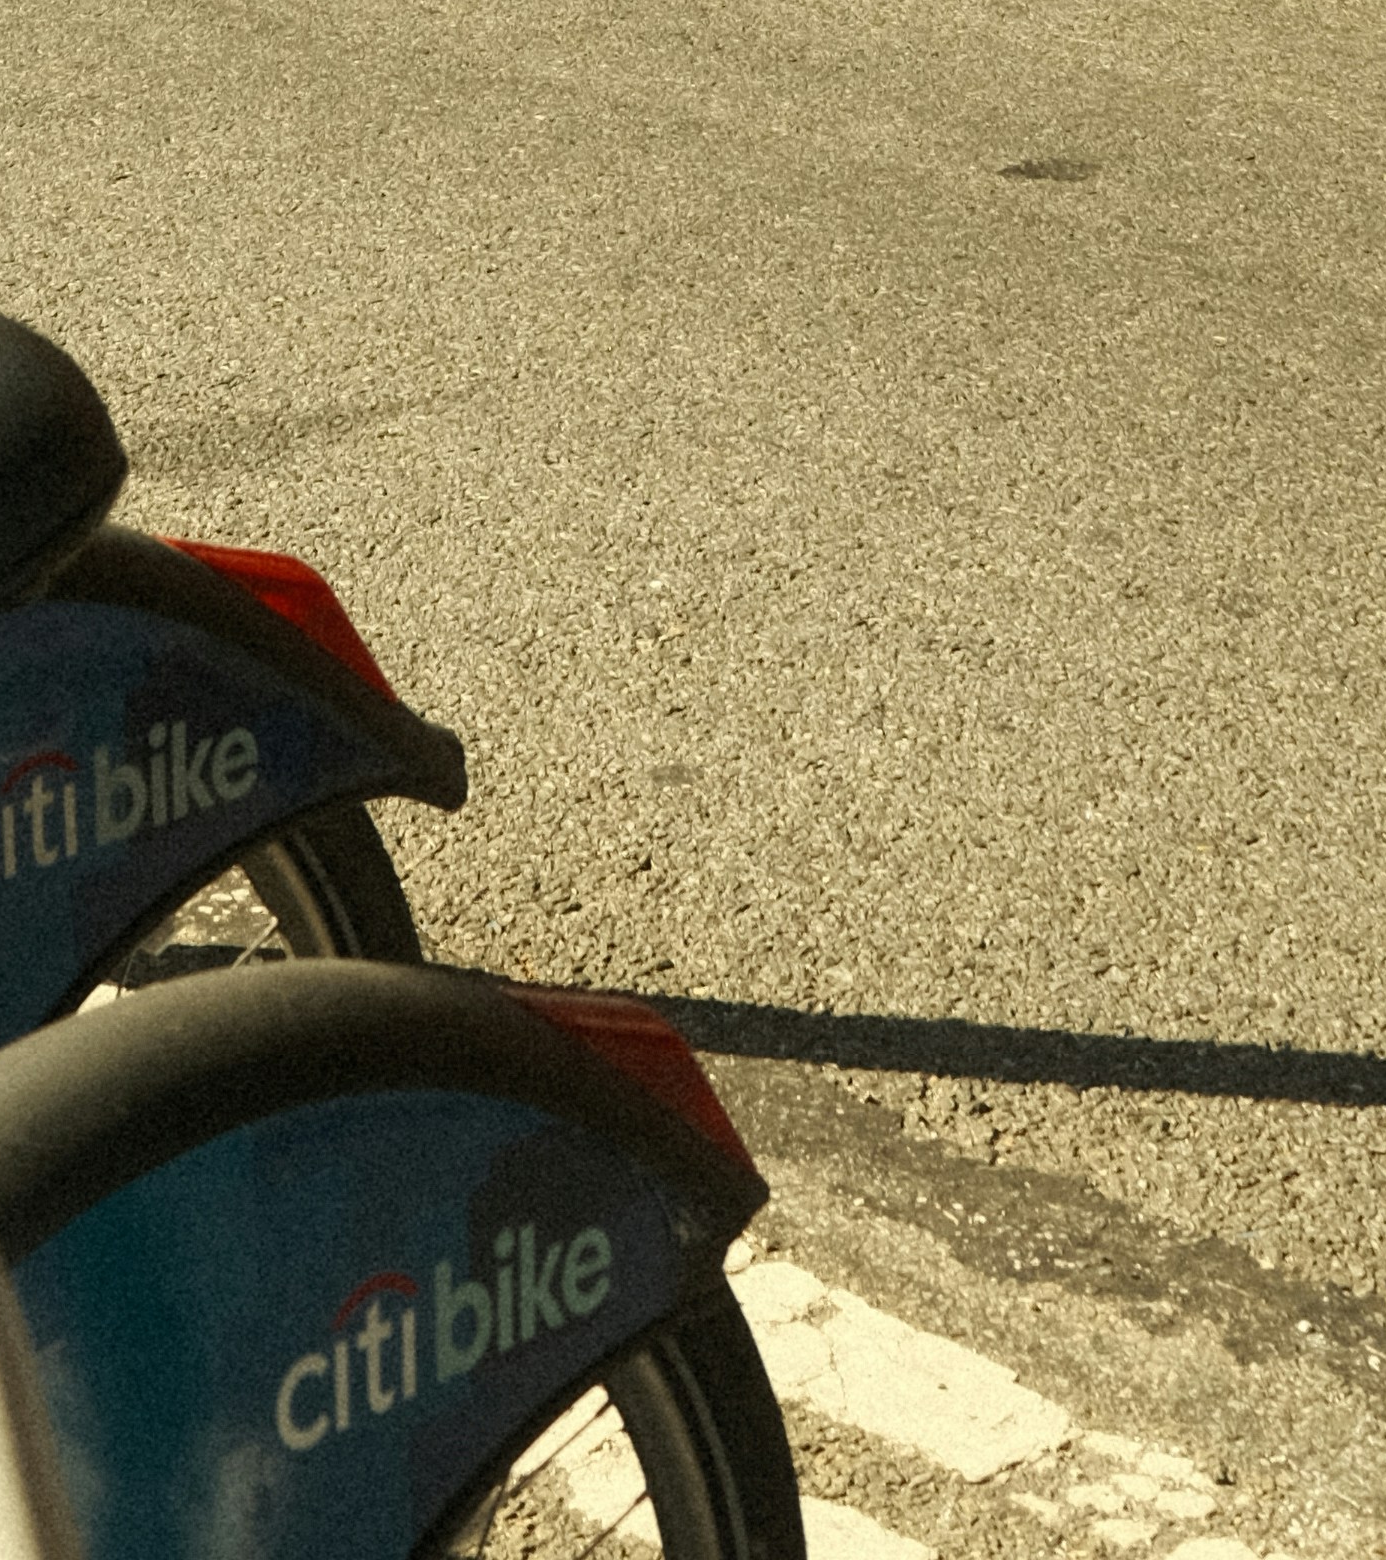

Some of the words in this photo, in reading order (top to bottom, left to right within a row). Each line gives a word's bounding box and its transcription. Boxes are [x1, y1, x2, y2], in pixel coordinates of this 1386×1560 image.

[94, 721, 260, 847] bike
[276, 1290, 416, 1452] citi
[435, 1223, 611, 1384] bike
